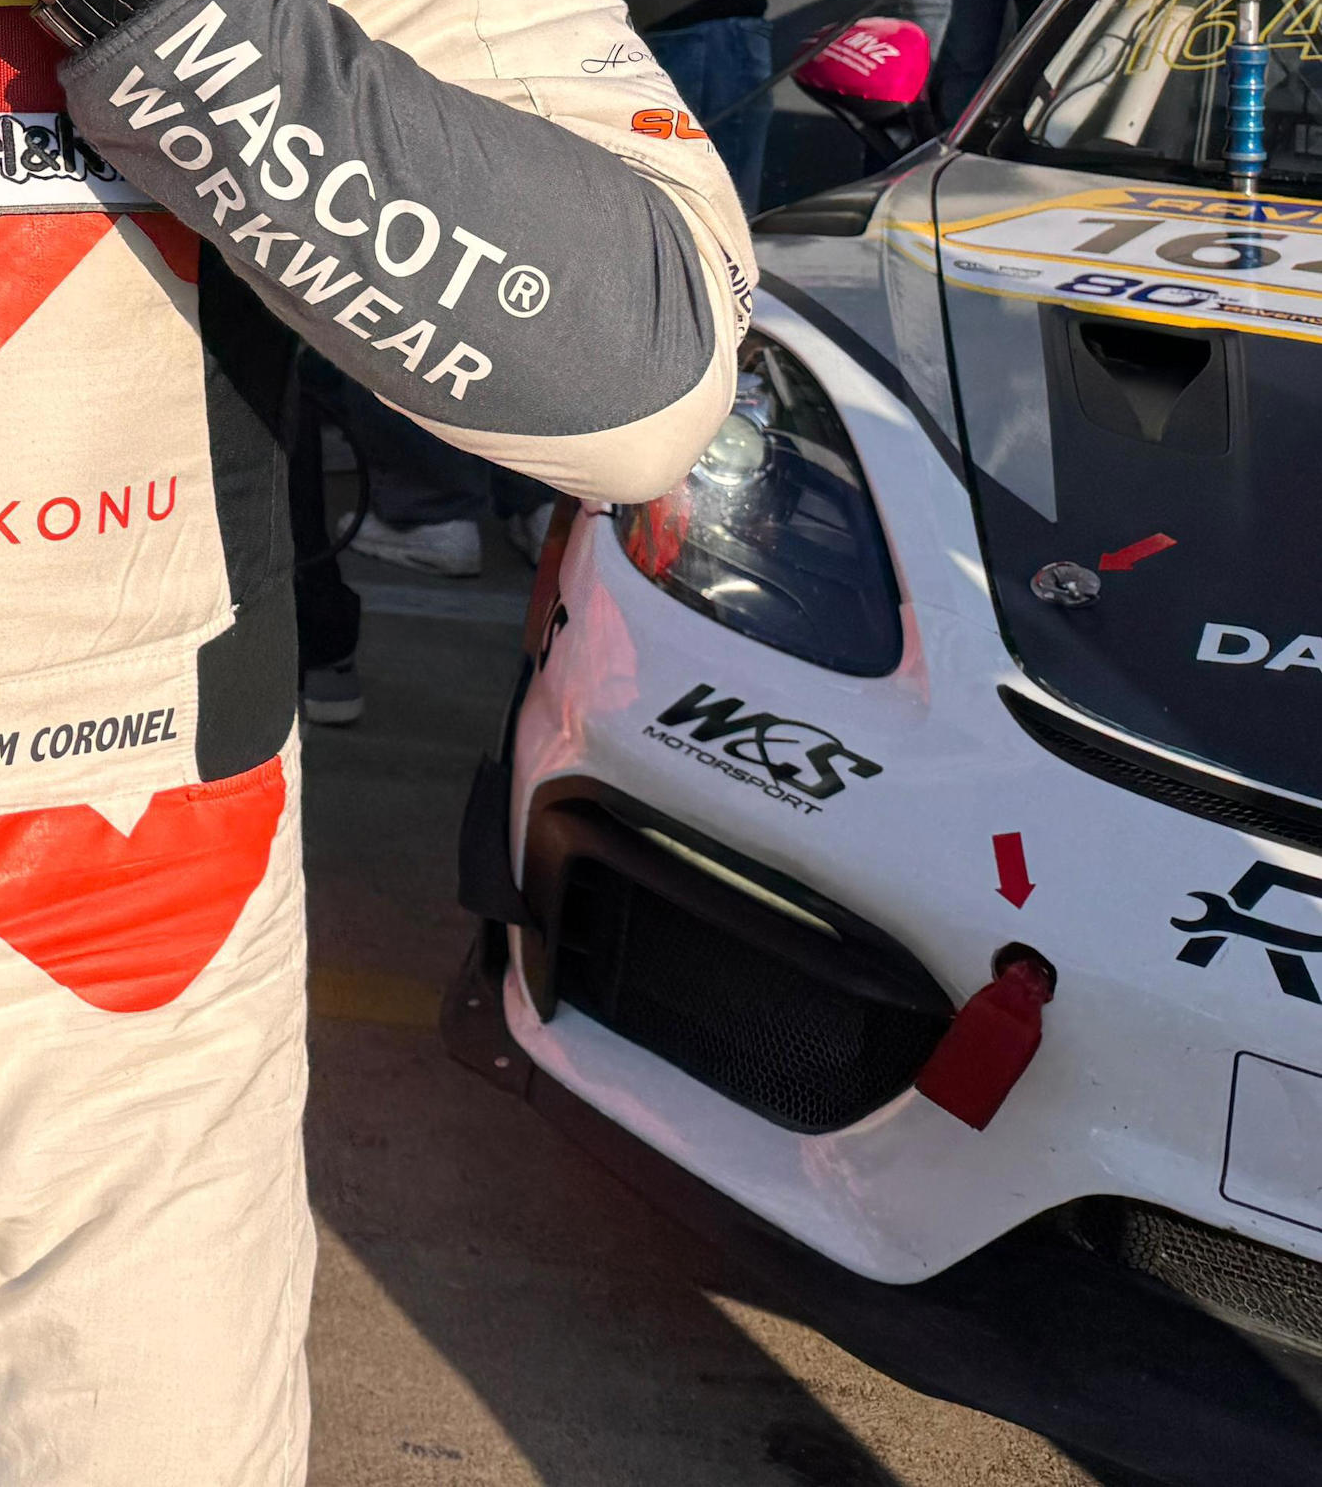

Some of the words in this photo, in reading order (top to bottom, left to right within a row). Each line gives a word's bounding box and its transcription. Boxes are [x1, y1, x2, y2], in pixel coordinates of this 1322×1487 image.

[153, 0, 551, 319] MASCOT®
[108, 65, 493, 401] WORKWEAR
[1073, 217, 1322, 273] 16
[1146, 198, 1322, 225] RAV
[29, 708, 178, 763] CORONEL
[642, 725, 823, 815] MOTORSPORT
[656, 683, 884, 800] W&S
